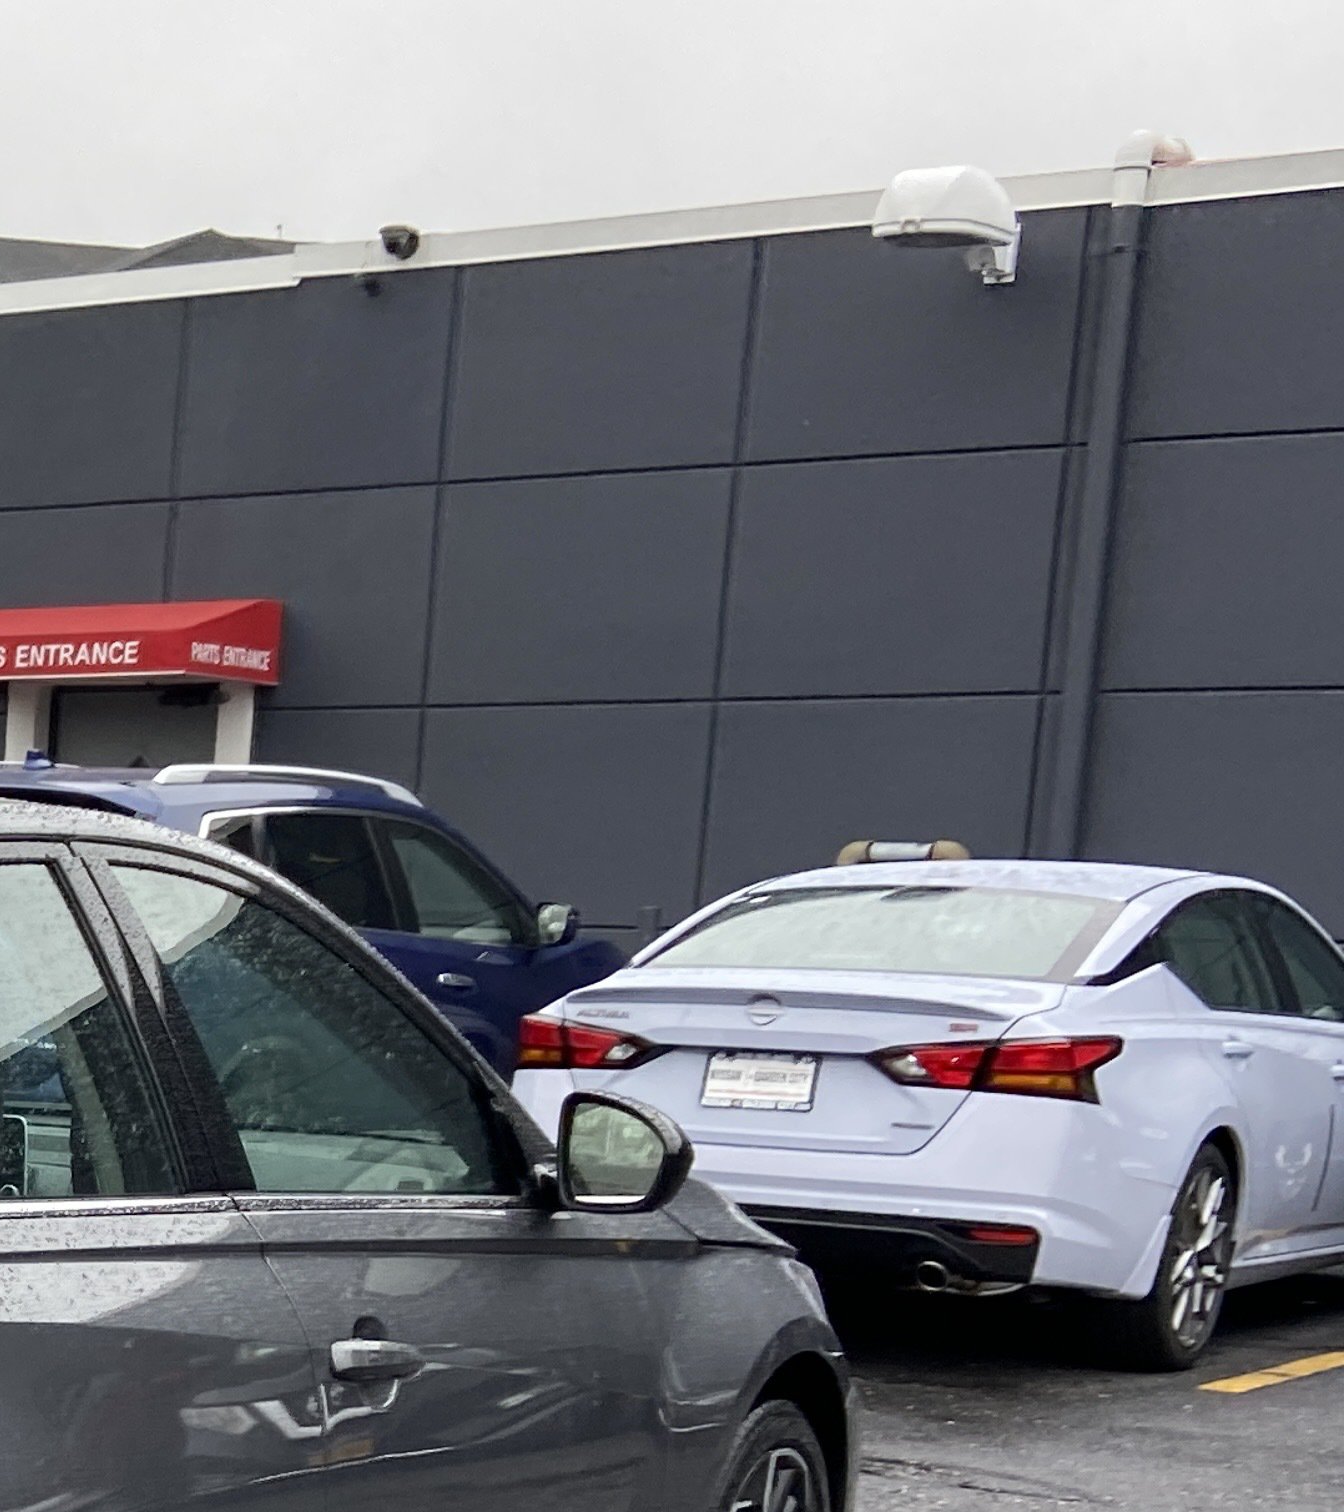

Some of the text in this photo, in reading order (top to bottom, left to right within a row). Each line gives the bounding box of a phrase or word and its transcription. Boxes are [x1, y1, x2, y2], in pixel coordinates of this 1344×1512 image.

[15, 641, 140, 668] ENTRANCE
[191, 642, 271, 671] PARTS ENTRANCE
